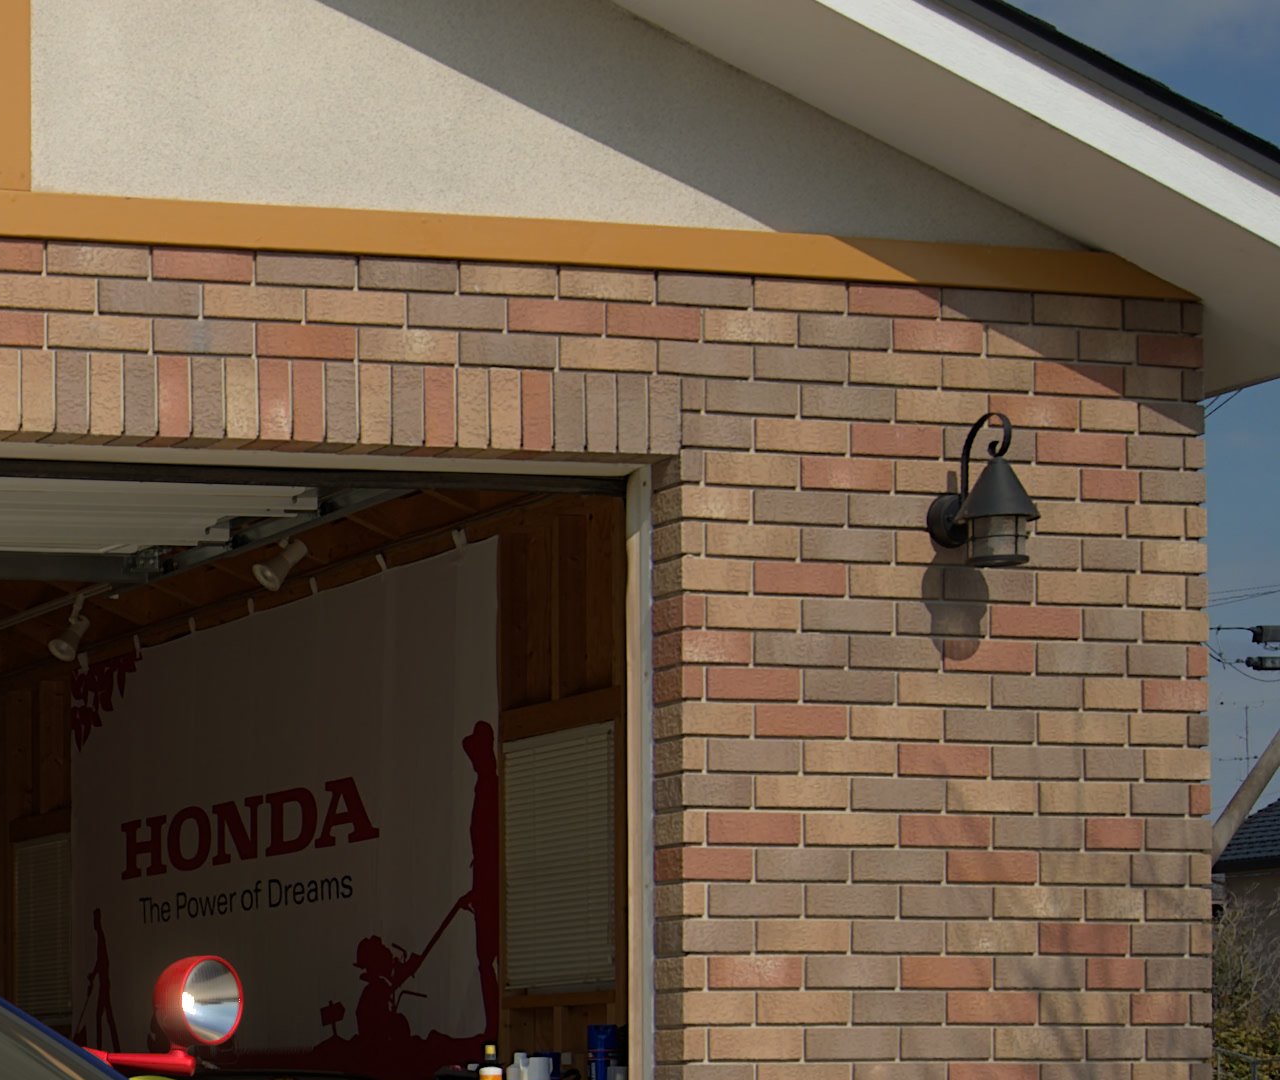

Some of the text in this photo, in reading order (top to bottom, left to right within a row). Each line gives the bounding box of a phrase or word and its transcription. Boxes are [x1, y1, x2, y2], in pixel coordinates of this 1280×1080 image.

[121, 777, 380, 880] HONDA
[139, 875, 353, 924] The Power of Dreams
